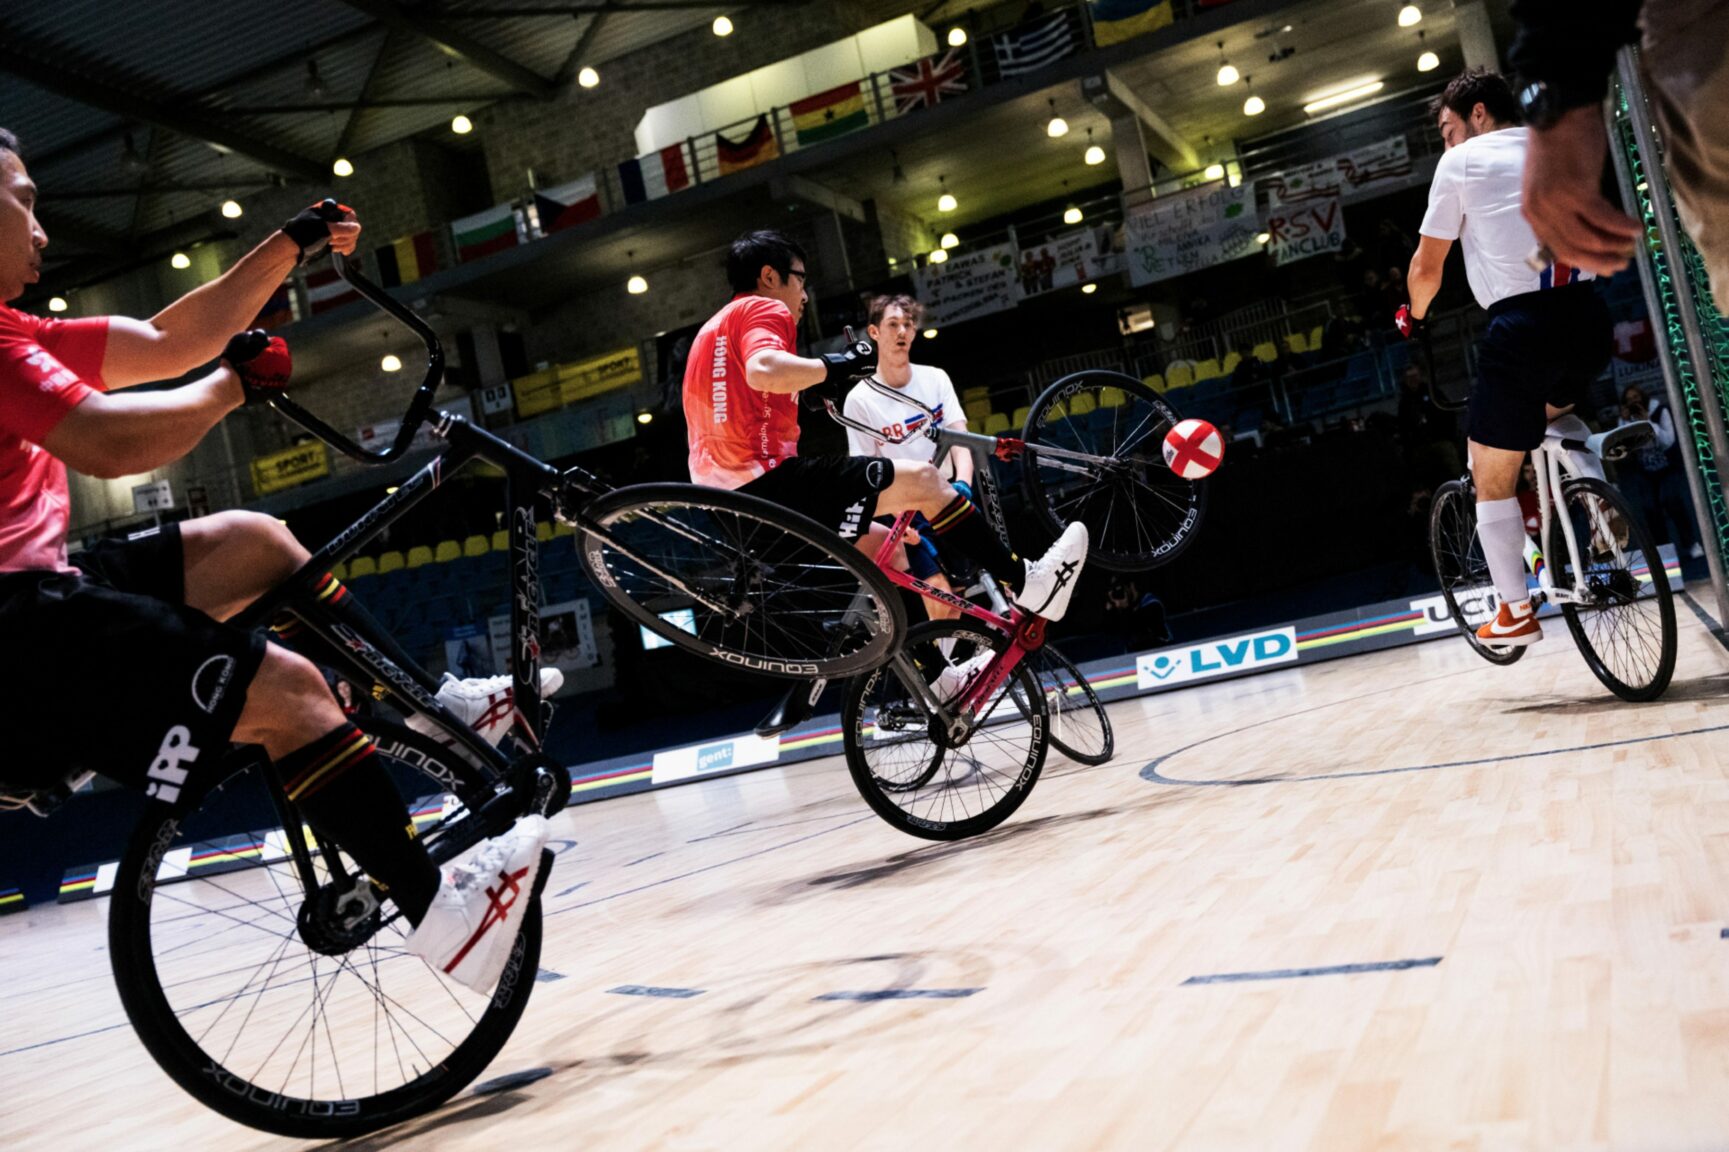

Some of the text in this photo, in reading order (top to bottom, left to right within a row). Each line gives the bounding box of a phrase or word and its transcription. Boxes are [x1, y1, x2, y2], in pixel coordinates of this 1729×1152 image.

[712, 335, 727, 424] HONG KONG
[1036, 379, 1084, 430] EQUINOX
[1152, 507, 1198, 558] EQUINOX
[1428, 592, 1498, 623] UCI
[709, 647, 819, 674] EQUINOX
[1190, 633, 1291, 674] LVD
[855, 668, 882, 748] EQUINOX
[364, 733, 466, 791] UINOX
[1016, 714, 1042, 792] EQUINOX
[202, 1061, 361, 1117] EQUINOX
